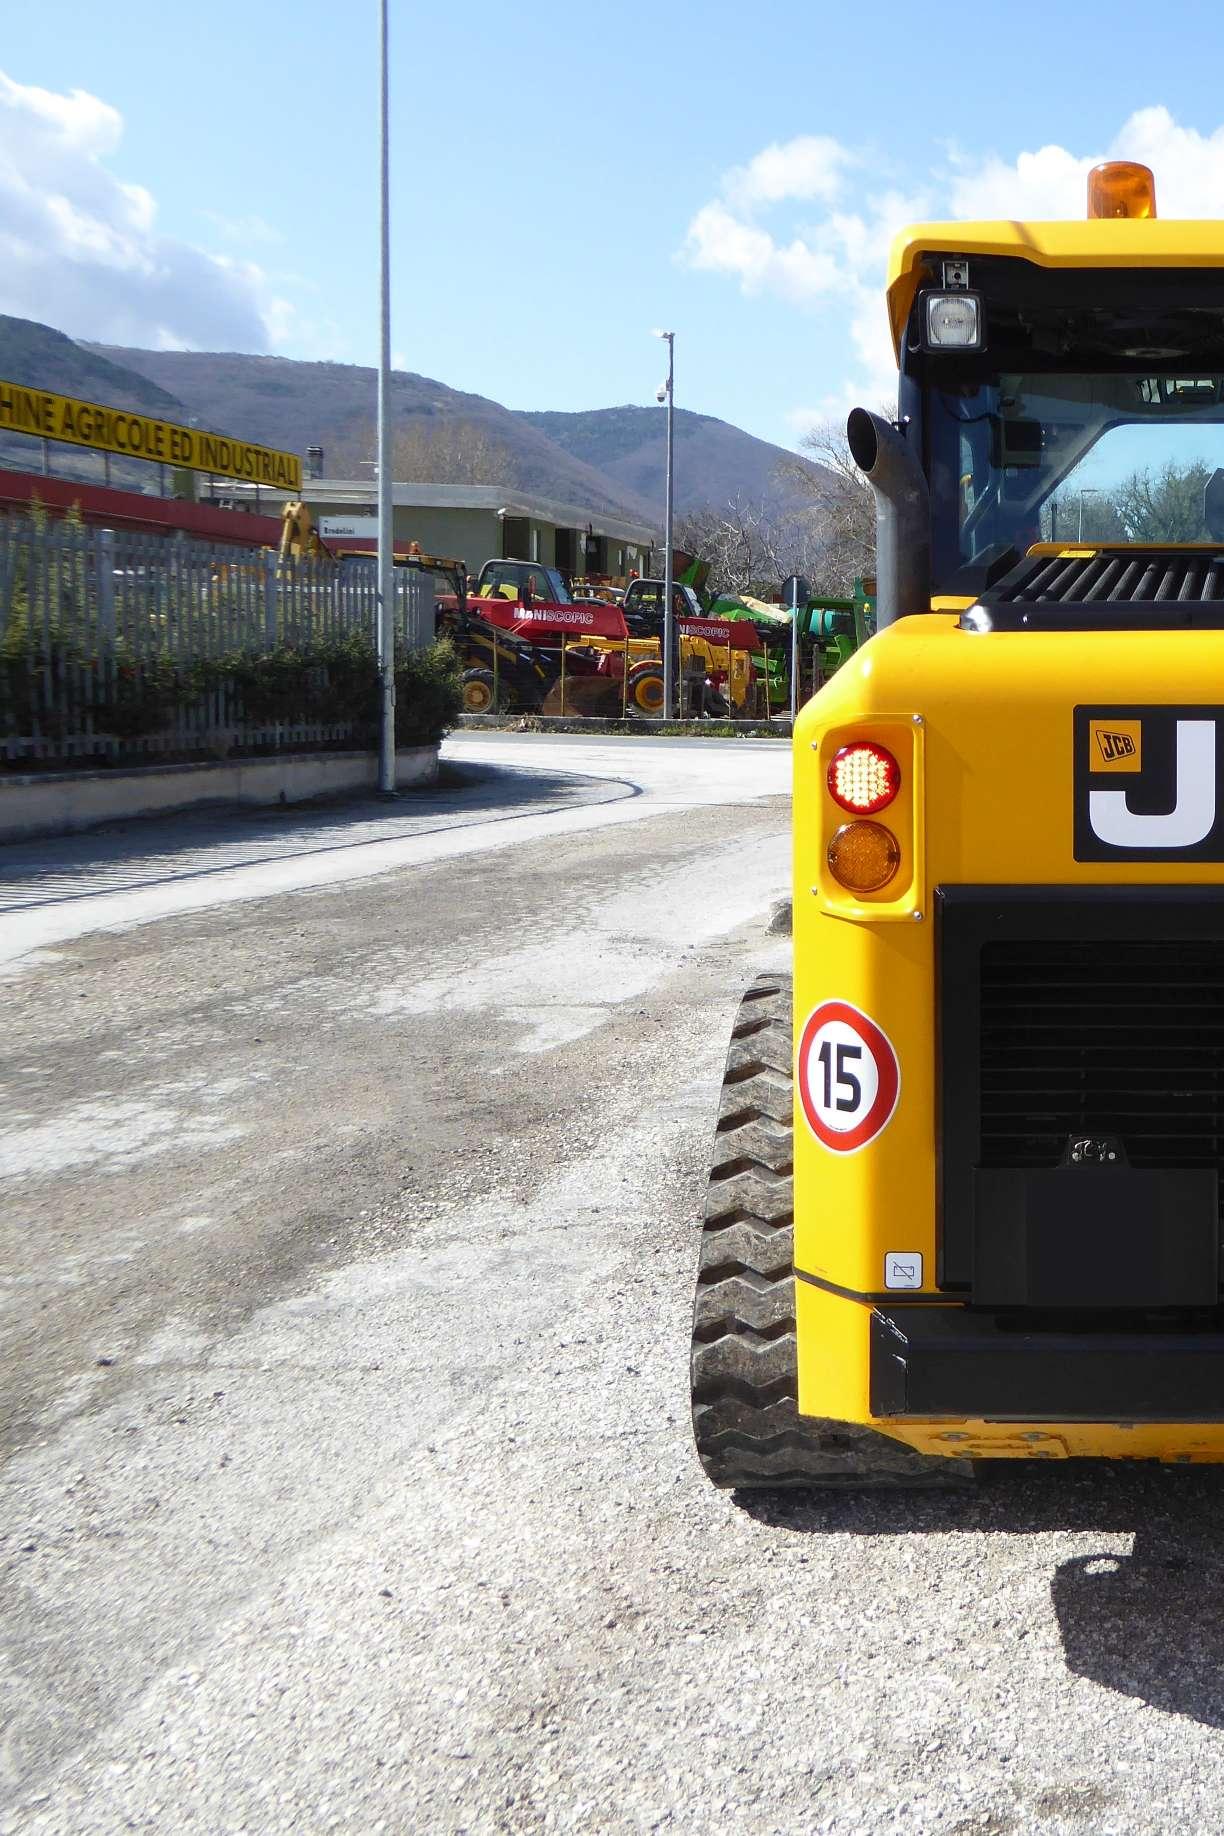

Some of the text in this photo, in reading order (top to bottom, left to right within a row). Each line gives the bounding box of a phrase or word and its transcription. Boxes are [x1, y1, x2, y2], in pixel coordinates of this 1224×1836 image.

[61, 401, 163, 456] AGRICOLE
[171, 426, 193, 462] ED
[200, 433, 299, 485] INDUSTRIALI
[513, 607, 594, 625] MANISCOPIC
[1102, 733, 1134, 759] JCB
[818, 1041, 862, 1113] 15
